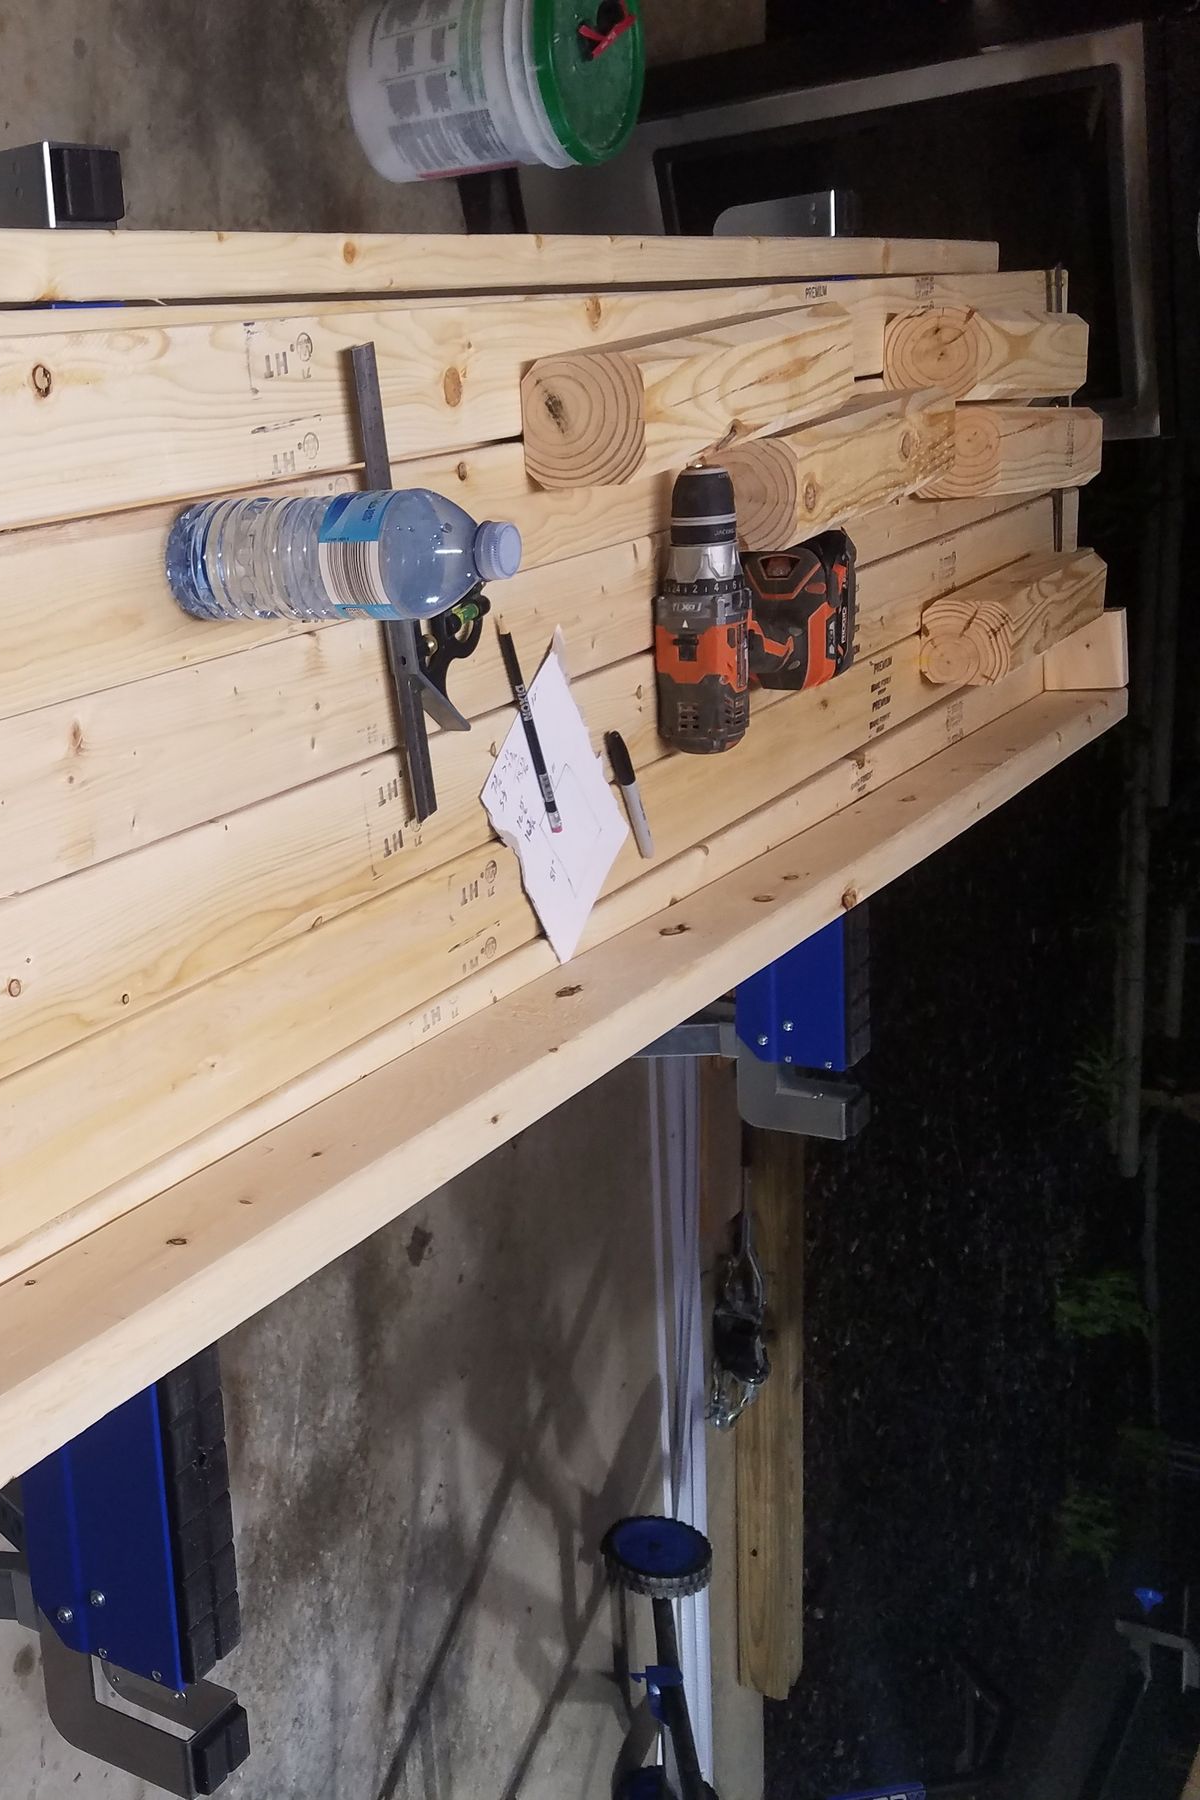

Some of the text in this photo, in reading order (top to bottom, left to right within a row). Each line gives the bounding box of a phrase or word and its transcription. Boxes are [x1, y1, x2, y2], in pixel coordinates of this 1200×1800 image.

[804, 285, 828, 299] PREMIUM
[263, 350, 289, 379] HT
[272, 450, 296, 476] HT
[692, 584, 698, 593] 2
[714, 582, 720, 592] 4
[514, 684, 534, 721] DIXON
[377, 778, 399, 807] HT
[383, 829, 404, 859] HT
[460, 879, 479, 907] HT
[422, 1005, 442, 1033] HT
